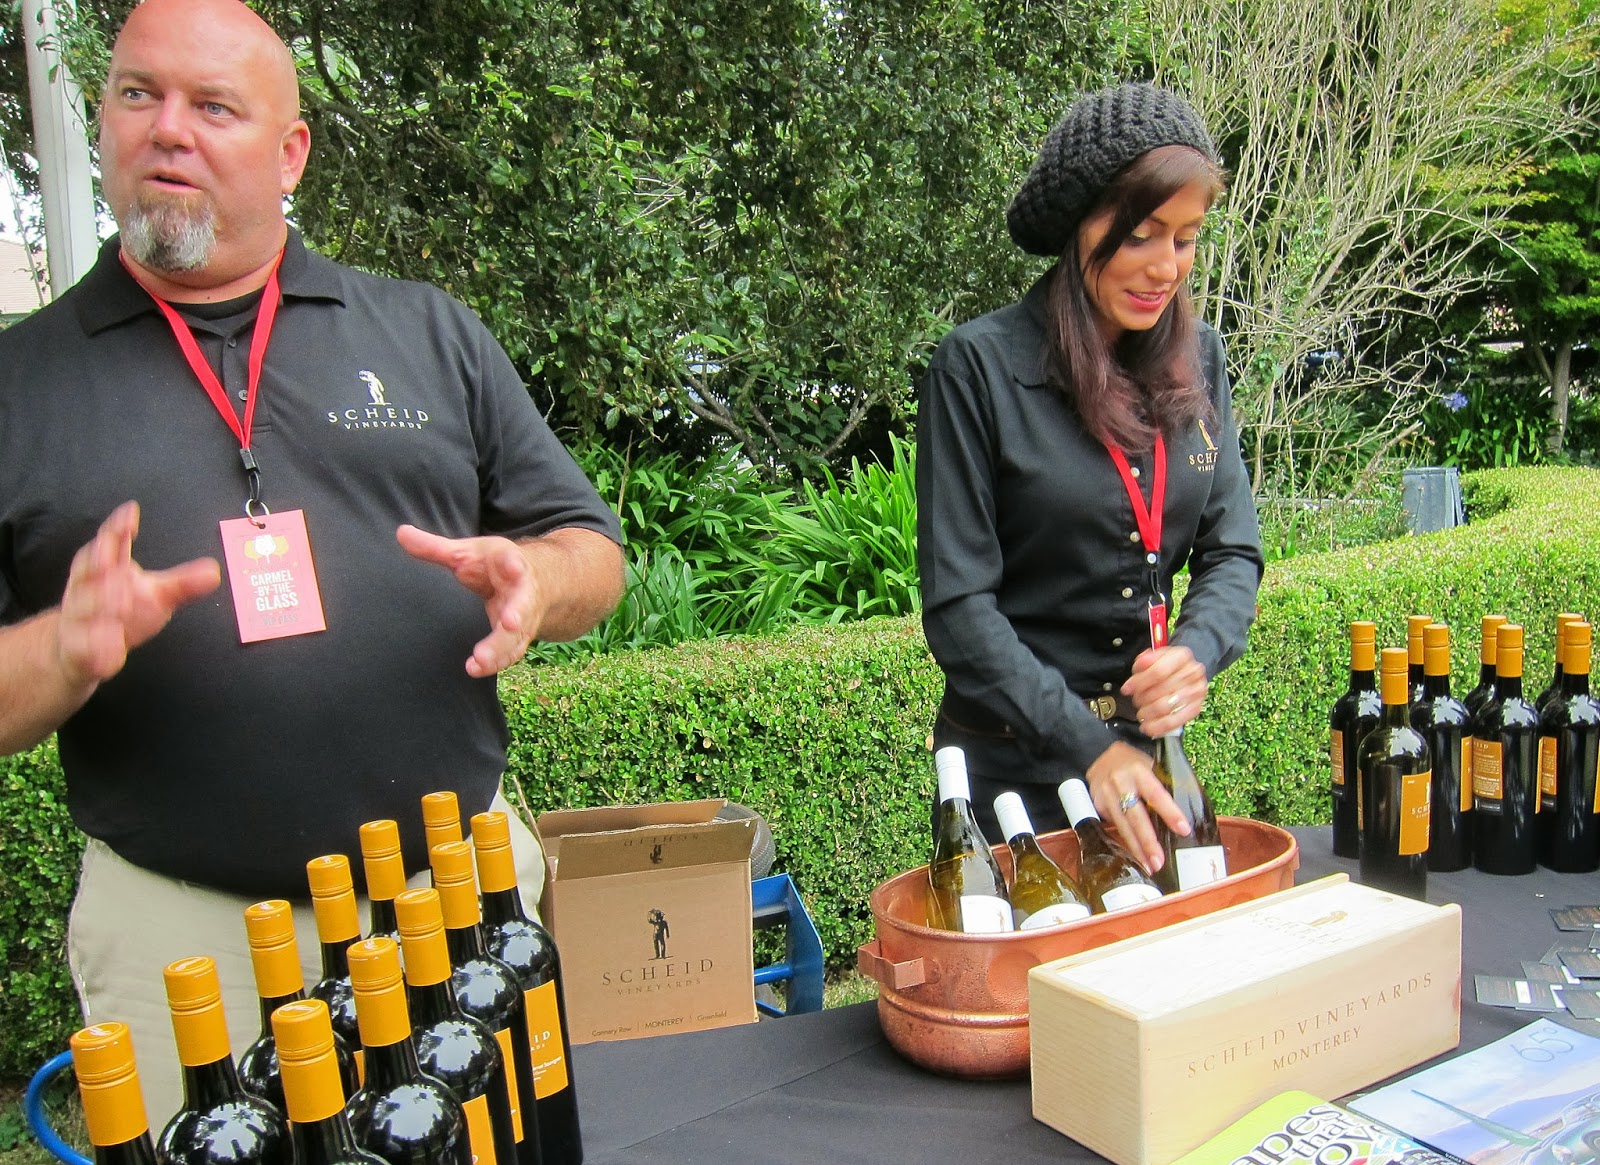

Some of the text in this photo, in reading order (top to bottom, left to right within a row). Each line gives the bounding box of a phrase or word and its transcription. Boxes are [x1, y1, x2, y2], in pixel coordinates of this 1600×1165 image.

[327, 408, 429, 423] SCHEID
[344, 421, 422, 430] VINEYARDS
[250, 569, 294, 587] CARMEL
[256, 592, 298, 612] GLASS
[602, 958, 713, 986] SCHEID
[617, 978, 701, 996] VINEYARDS
[645, 1017, 684, 1029] MONTEREY
[697, 1010, 727, 1022] Greenfield
[591, 1027, 617, 1038] Cannery
[1187, 972, 1433, 1079] SCHEID VINEYARDS
[1272, 1025, 1362, 1072] MONTEREY
[1291, 1116, 1361, 1158] that
